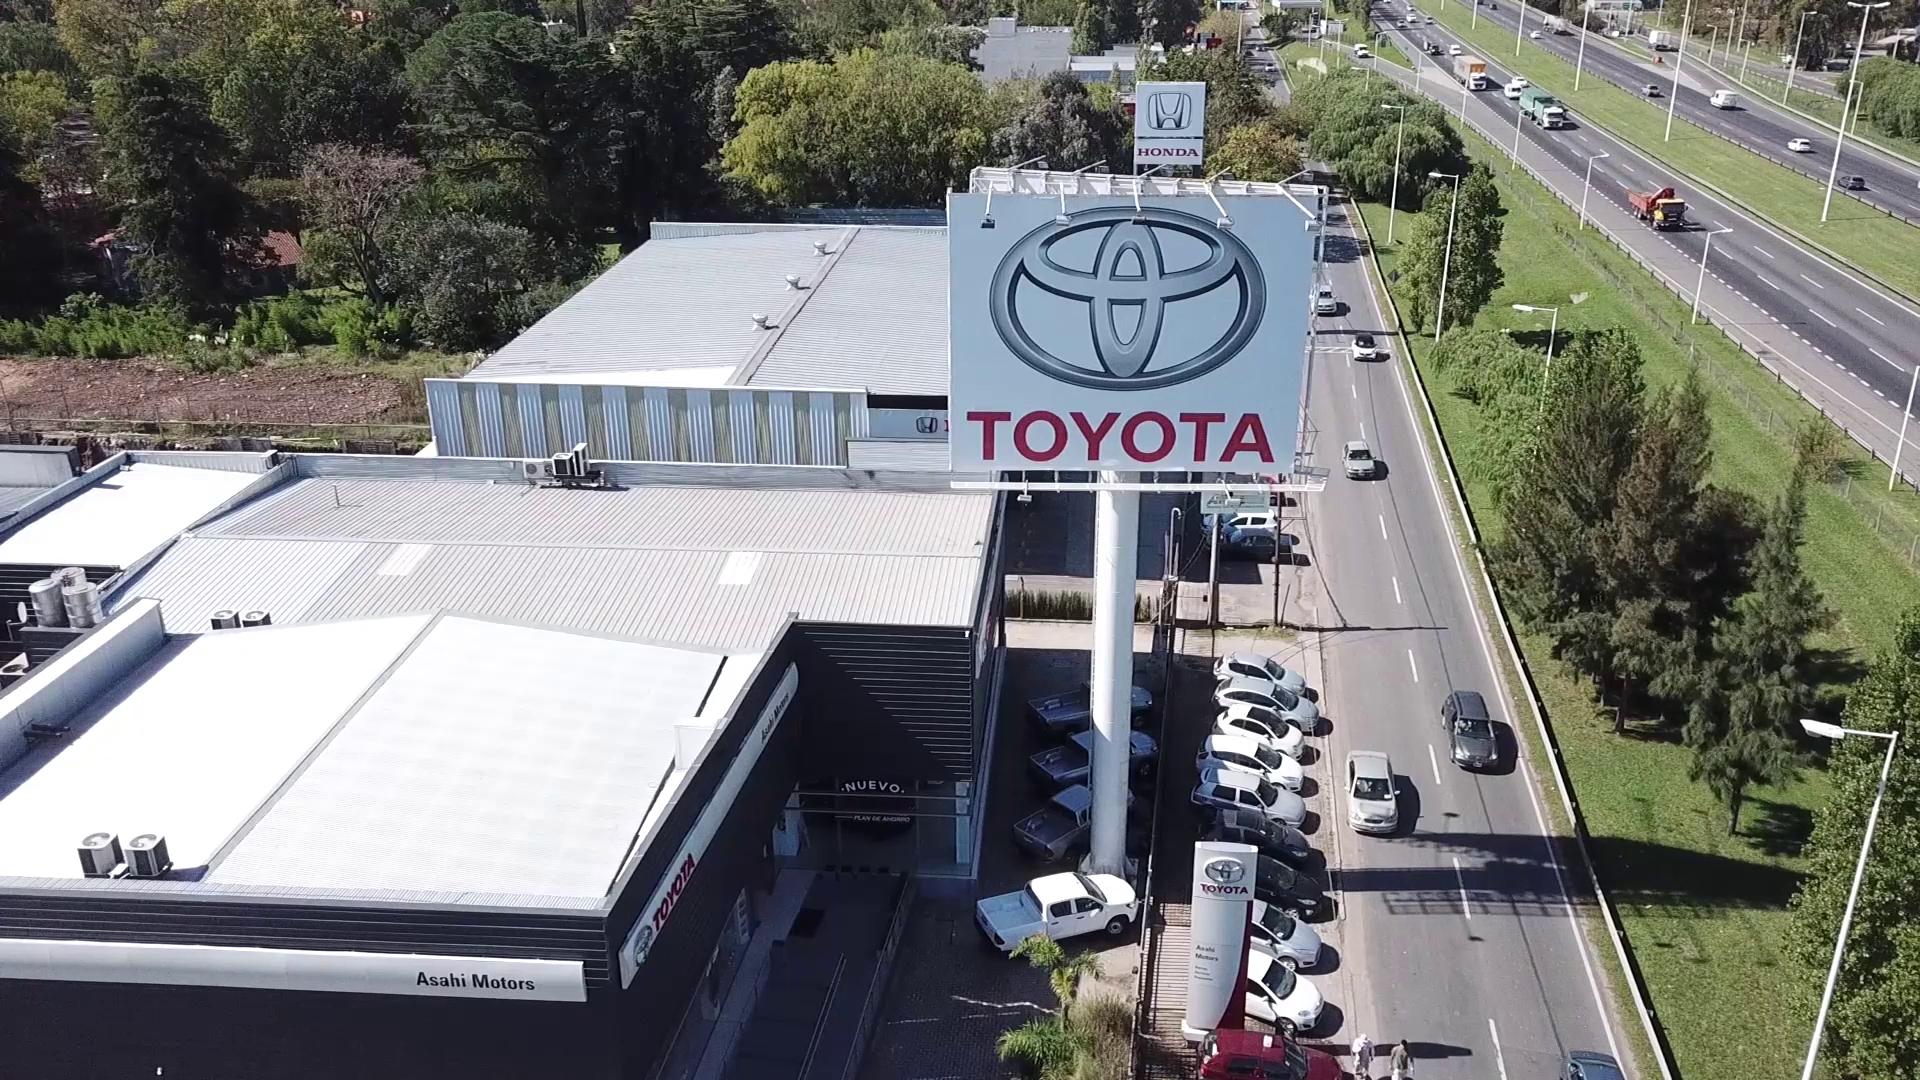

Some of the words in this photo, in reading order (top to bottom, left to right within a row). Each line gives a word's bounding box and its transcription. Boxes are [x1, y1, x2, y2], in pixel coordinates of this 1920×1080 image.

[1137, 147, 1200, 157] HONDA
[966, 410, 1275, 463] TOYOTA
[653, 853, 695, 931] TOYOTA
[1200, 883, 1248, 895] TOYOTA
[416, 971, 467, 988] Asahi
[471, 973, 536, 991] Motors
